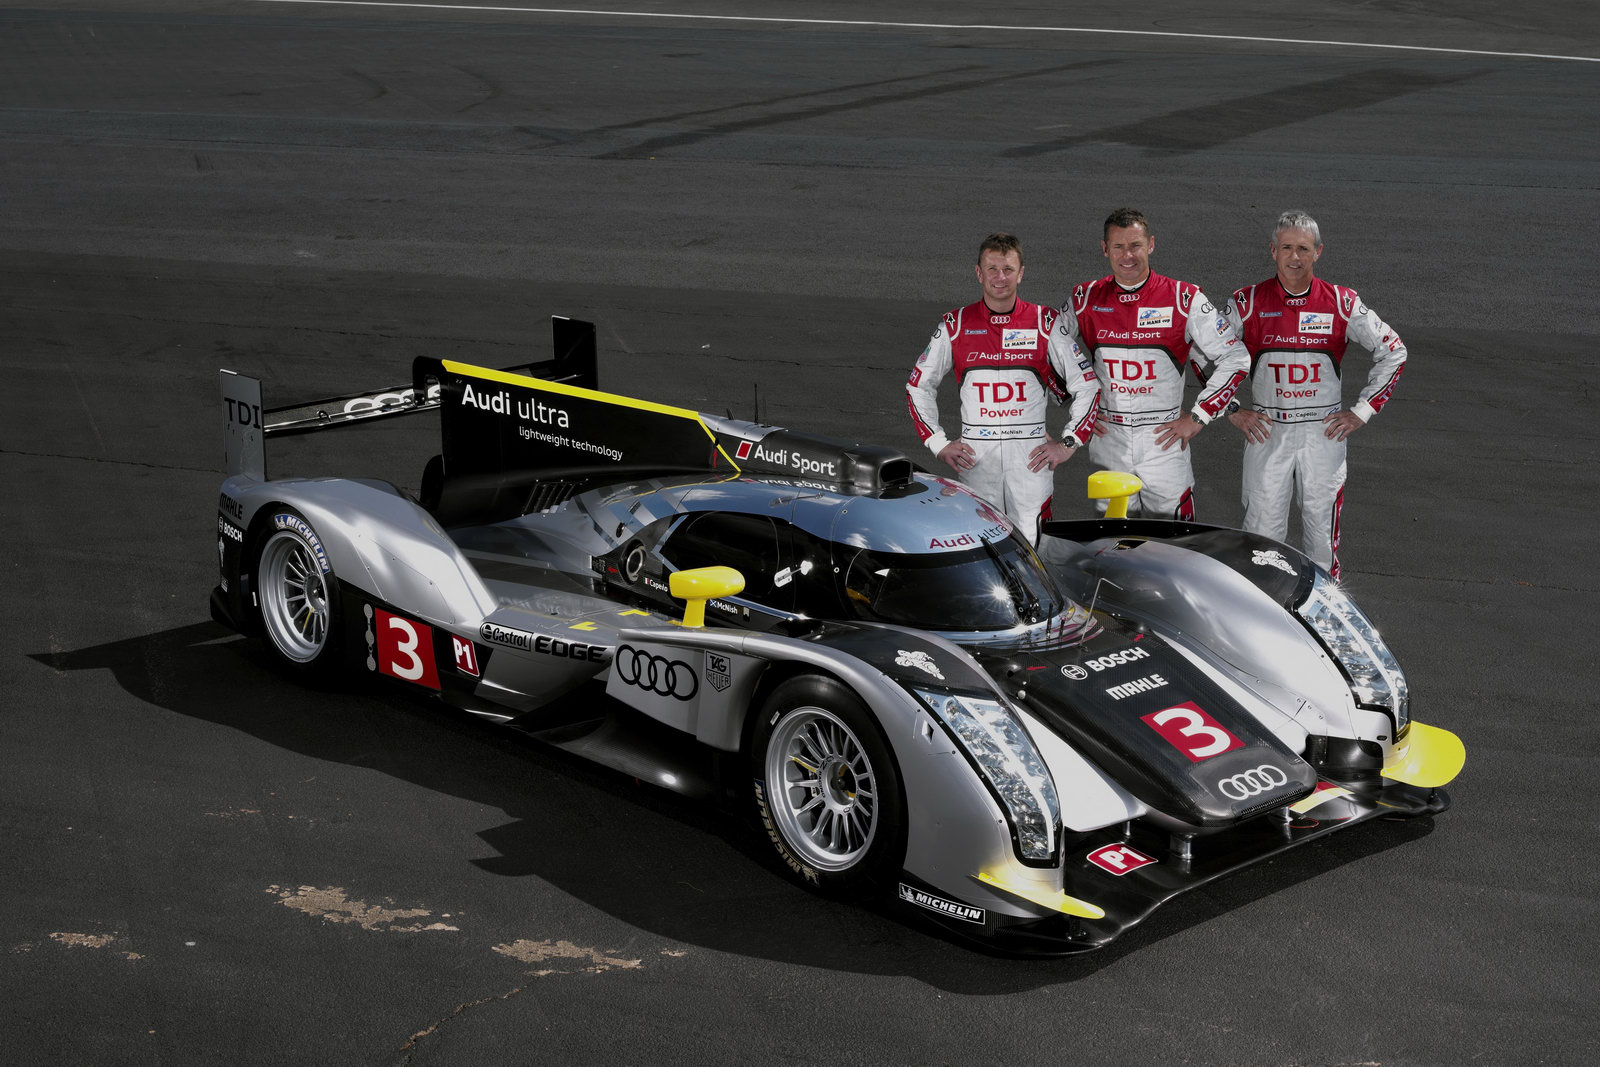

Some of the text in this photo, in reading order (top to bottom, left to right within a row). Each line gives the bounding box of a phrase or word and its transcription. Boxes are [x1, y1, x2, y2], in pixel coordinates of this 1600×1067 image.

[1108, 331, 1161, 340] Audi Sport
[1275, 335, 1328, 345] Audi Sport
[979, 352, 1033, 361] Audi Sport
[1103, 358, 1157, 381] TDI
[1268, 363, 1321, 384] TDI
[972, 381, 1027, 403] TDI
[1110, 382, 1154, 395] Power
[1209, 383, 1238, 408] TDI
[1275, 388, 1318, 398] Power
[224, 397, 261, 429] TDI
[462, 383, 570, 428] Audi ultra
[980, 407, 1024, 418] Power
[519, 426, 623, 461] lightweight technology
[754, 444, 836, 476] Audi Sport
[220, 492, 243, 520] MAHLE
[223, 522, 243, 542] BOSCH
[286, 516, 329, 572] MICHELIN
[929, 524, 1007, 549] Audi ultra
[717, 601, 738, 614] McNish
[389, 617, 424, 680] 3
[453, 637, 474, 670] P1
[492, 628, 608, 663] Castrol EDGE
[710, 655, 727, 672] TAG
[1084, 646, 1151, 673] BOSCH
[706, 671, 730, 690] HEUER
[1105, 673, 1169, 700] MAHLE
[1152, 707, 1231, 758] 3
[754, 781, 802, 875] MICHELIN
[1098, 846, 1148, 870] P1
[916, 893, 982, 920] MICHELIN
